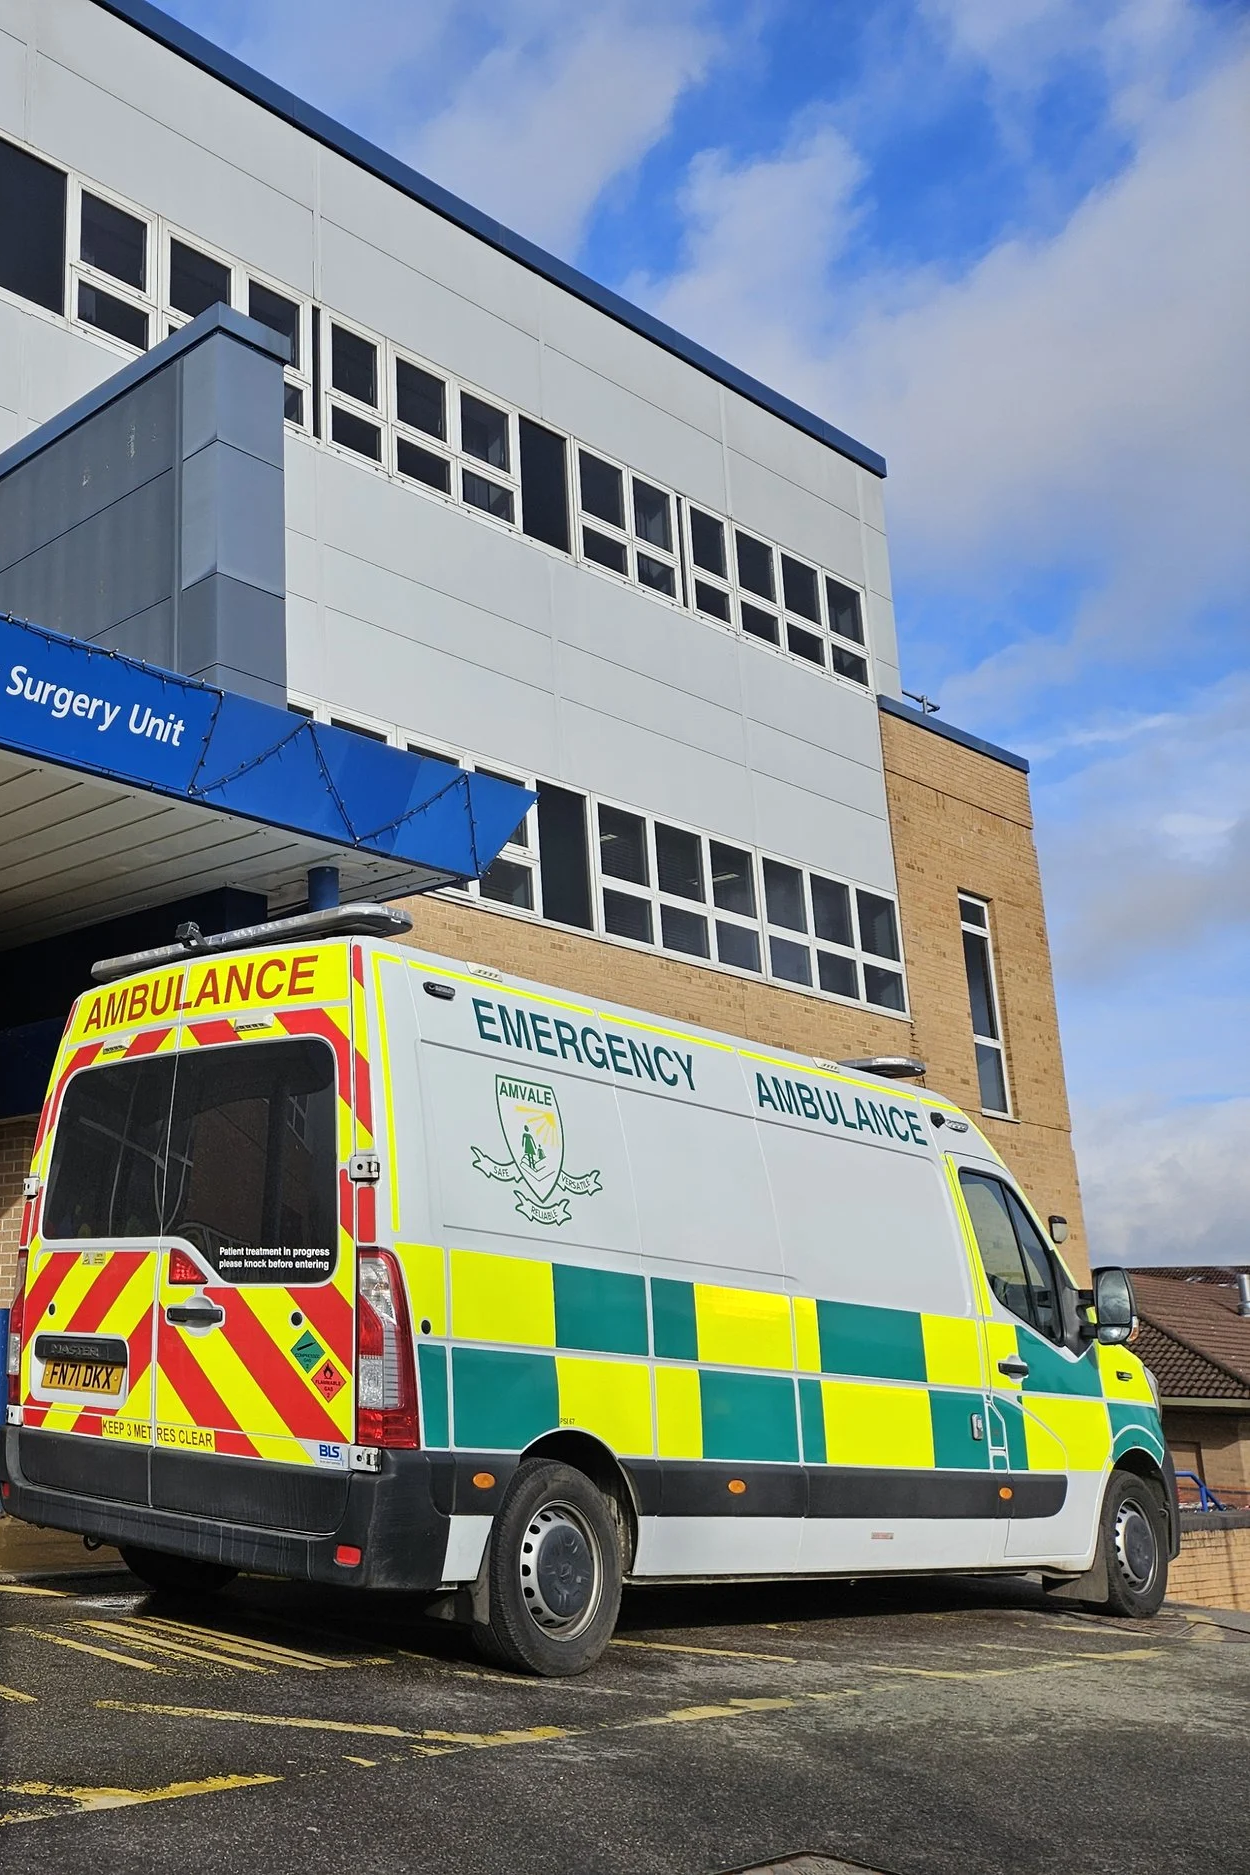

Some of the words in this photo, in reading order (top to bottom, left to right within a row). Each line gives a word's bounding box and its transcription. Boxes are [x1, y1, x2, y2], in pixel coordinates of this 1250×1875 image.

[6, 665, 121, 731] Surgery
[128, 703, 185, 747] Unit
[83, 955, 319, 1033] AMBULANCE
[471, 997, 696, 1091] EMERGENCY
[755, 1072, 928, 1146] AMBULANCE
[499, 1081, 552, 1107] AMVALE
[493, 1165, 510, 1177] SAFE
[561, 1175, 591, 1190] VERSATILE
[531, 1205, 558, 1220] RELIABLE
[219, 1246, 244, 1256] Patient
[245, 1247, 282, 1256] treatment
[283, 1246, 291, 1256] in
[293, 1248, 330, 1258] progress
[219, 1259, 243, 1269] please
[244, 1259, 267, 1268] knock
[268, 1259, 293, 1268] before
[295, 1259, 329, 1271] entering
[51, 1343, 99, 1357] MASTER
[82, 1364, 115, 1390] DKX
[103, 1420, 124, 1435] KEEP
[127, 1423, 132, 1437] 3
[134, 1423, 176, 1442] METRES
[178, 1429, 213, 1448] CLEAR
[319, 1444, 340, 1458] BLS
